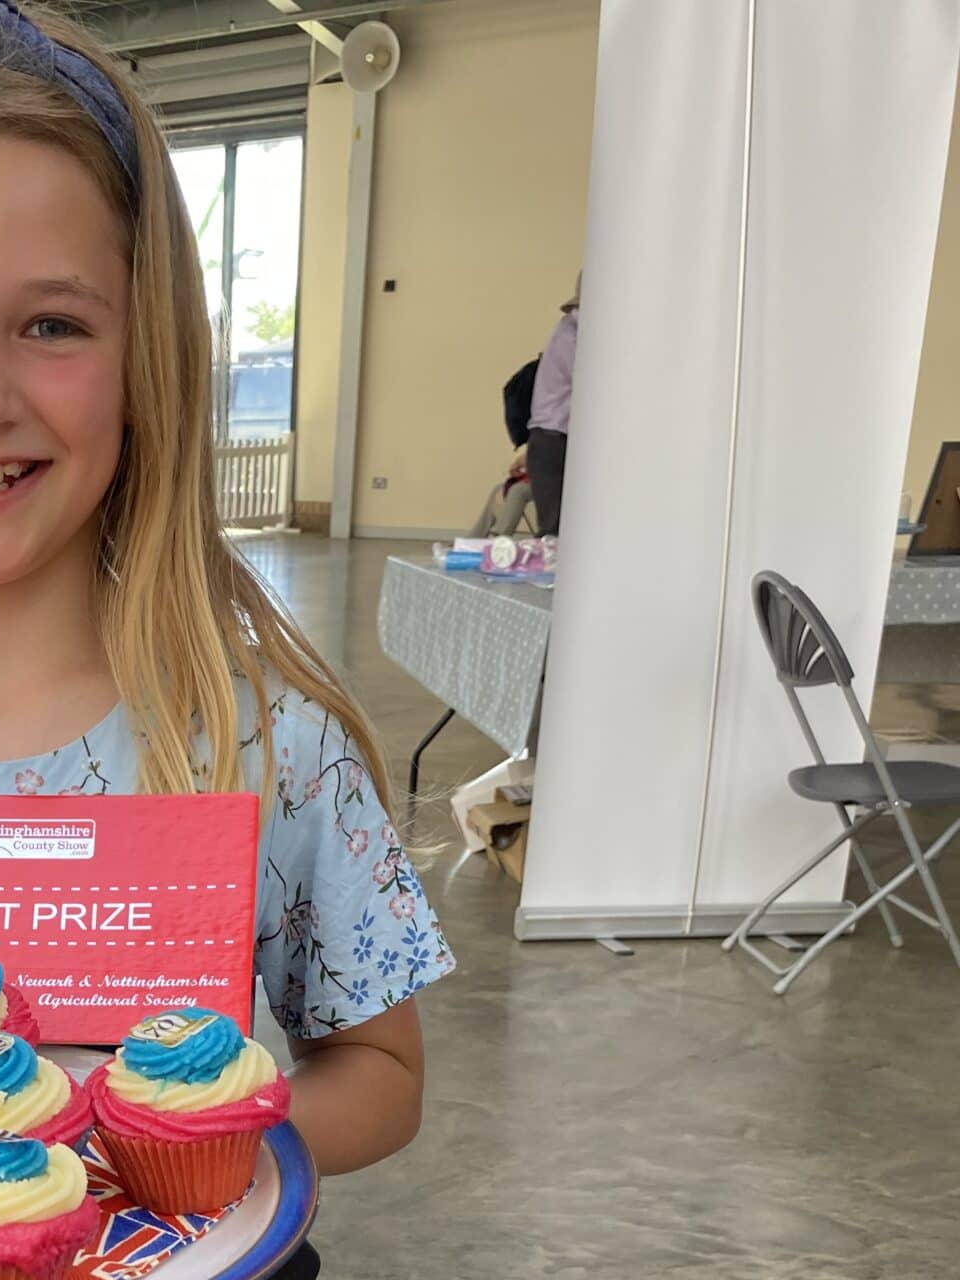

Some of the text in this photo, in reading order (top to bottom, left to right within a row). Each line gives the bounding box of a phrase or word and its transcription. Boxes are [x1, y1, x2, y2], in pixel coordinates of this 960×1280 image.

[12, 840, 89, 852] County Show
[32, 902, 153, 931] PRIZE
[11, 973, 230, 989] Newark & Nottinghamshire
[37, 993, 198, 1008] Agricultural Society
[142, 1019, 176, 1038] 70
